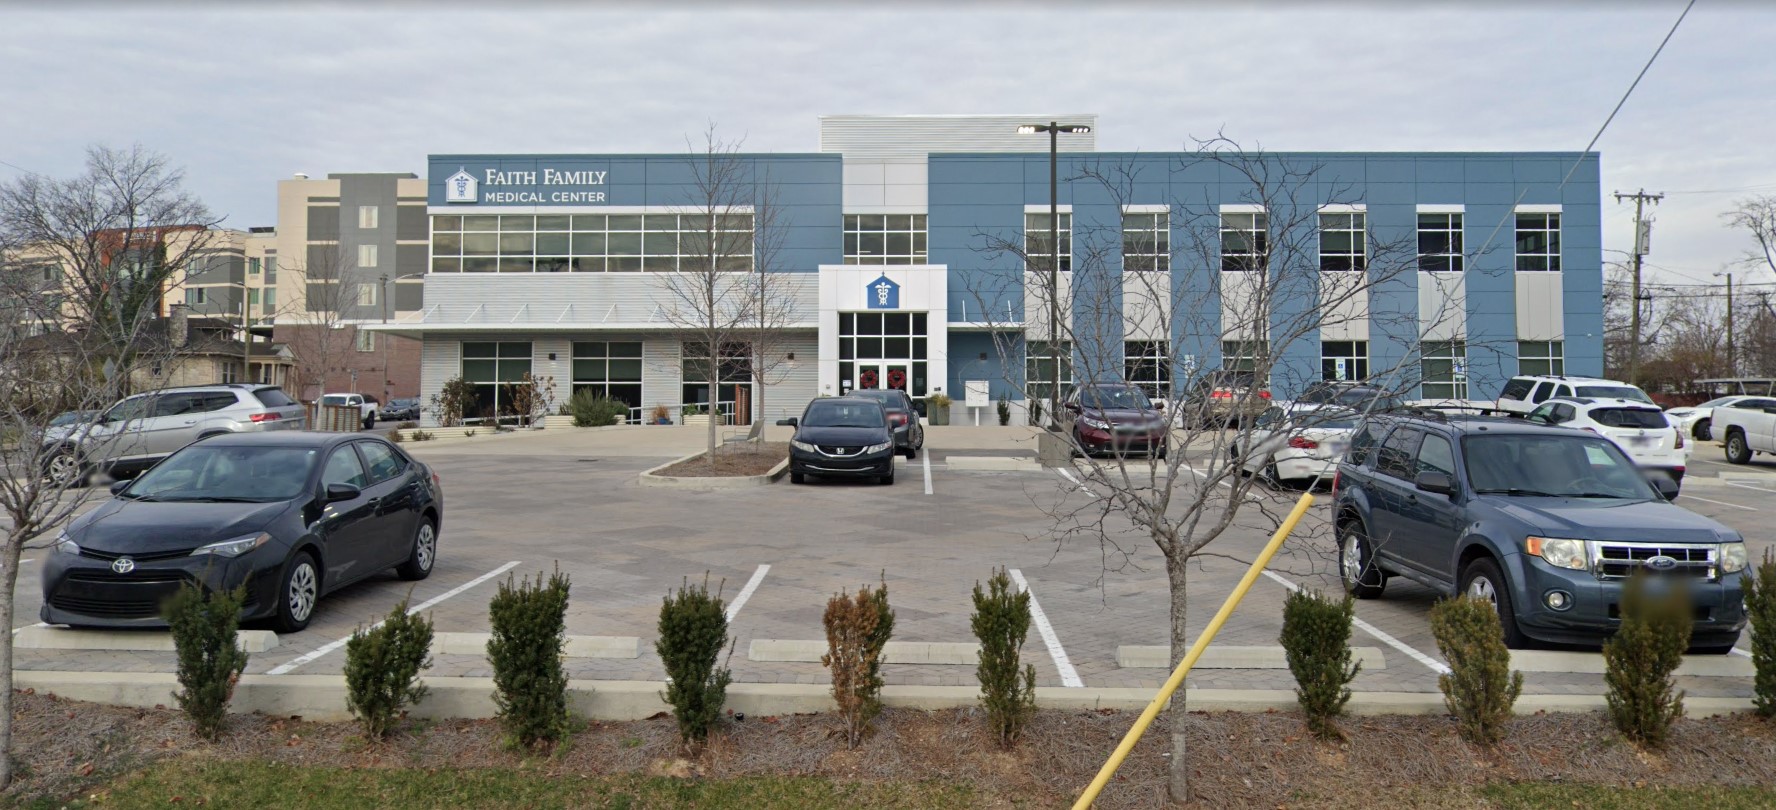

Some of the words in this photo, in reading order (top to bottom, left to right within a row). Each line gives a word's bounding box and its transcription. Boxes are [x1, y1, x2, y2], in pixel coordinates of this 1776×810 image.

[485, 168, 537, 185] FAITH
[543, 168, 607, 185] FAMILY
[485, 192, 547, 202] MEDICAL
[551, 192, 605, 202] CENTER
